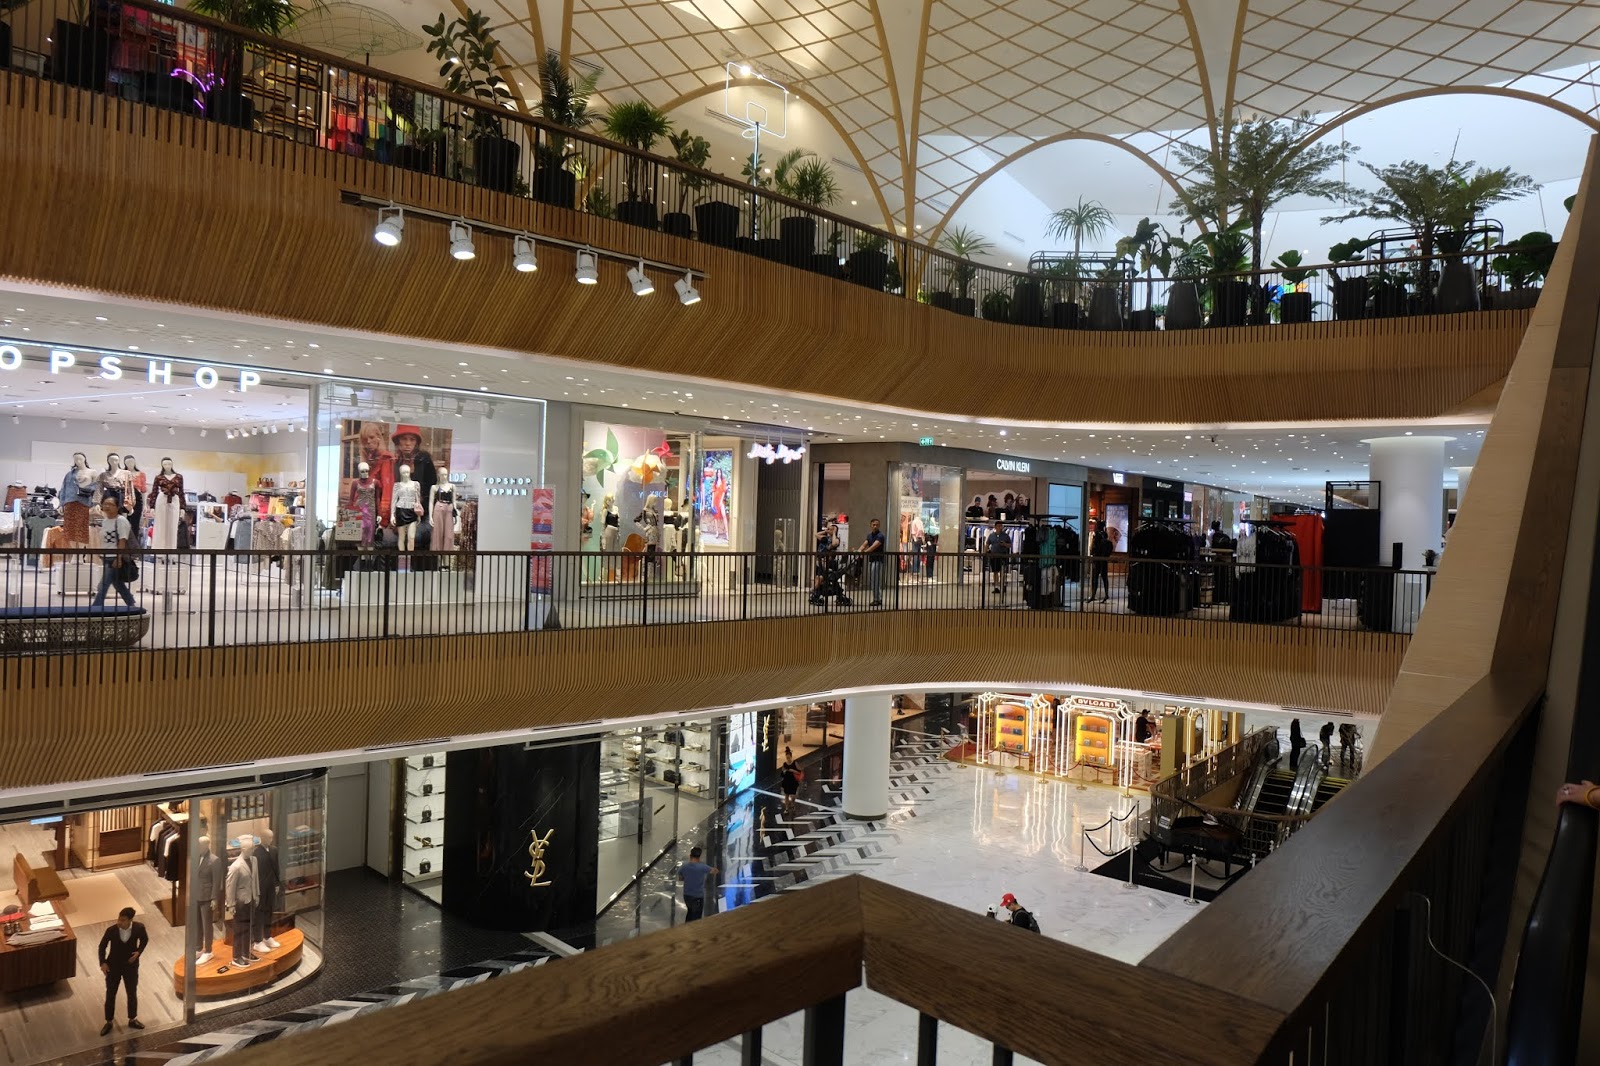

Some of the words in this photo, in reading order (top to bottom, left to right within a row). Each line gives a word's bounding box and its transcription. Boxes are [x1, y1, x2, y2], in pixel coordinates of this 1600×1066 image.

[0, 345, 261, 393] OPSHOP
[996, 458, 1015, 471] CALVIN
[1015, 461, 1030, 473] KLEIN
[483, 477, 531, 485] TOPSHOP
[486, 488, 527, 496] TOPMAN
[1077, 699, 1114, 708] BVLGARI
[523, 828, 554, 886] YSL
